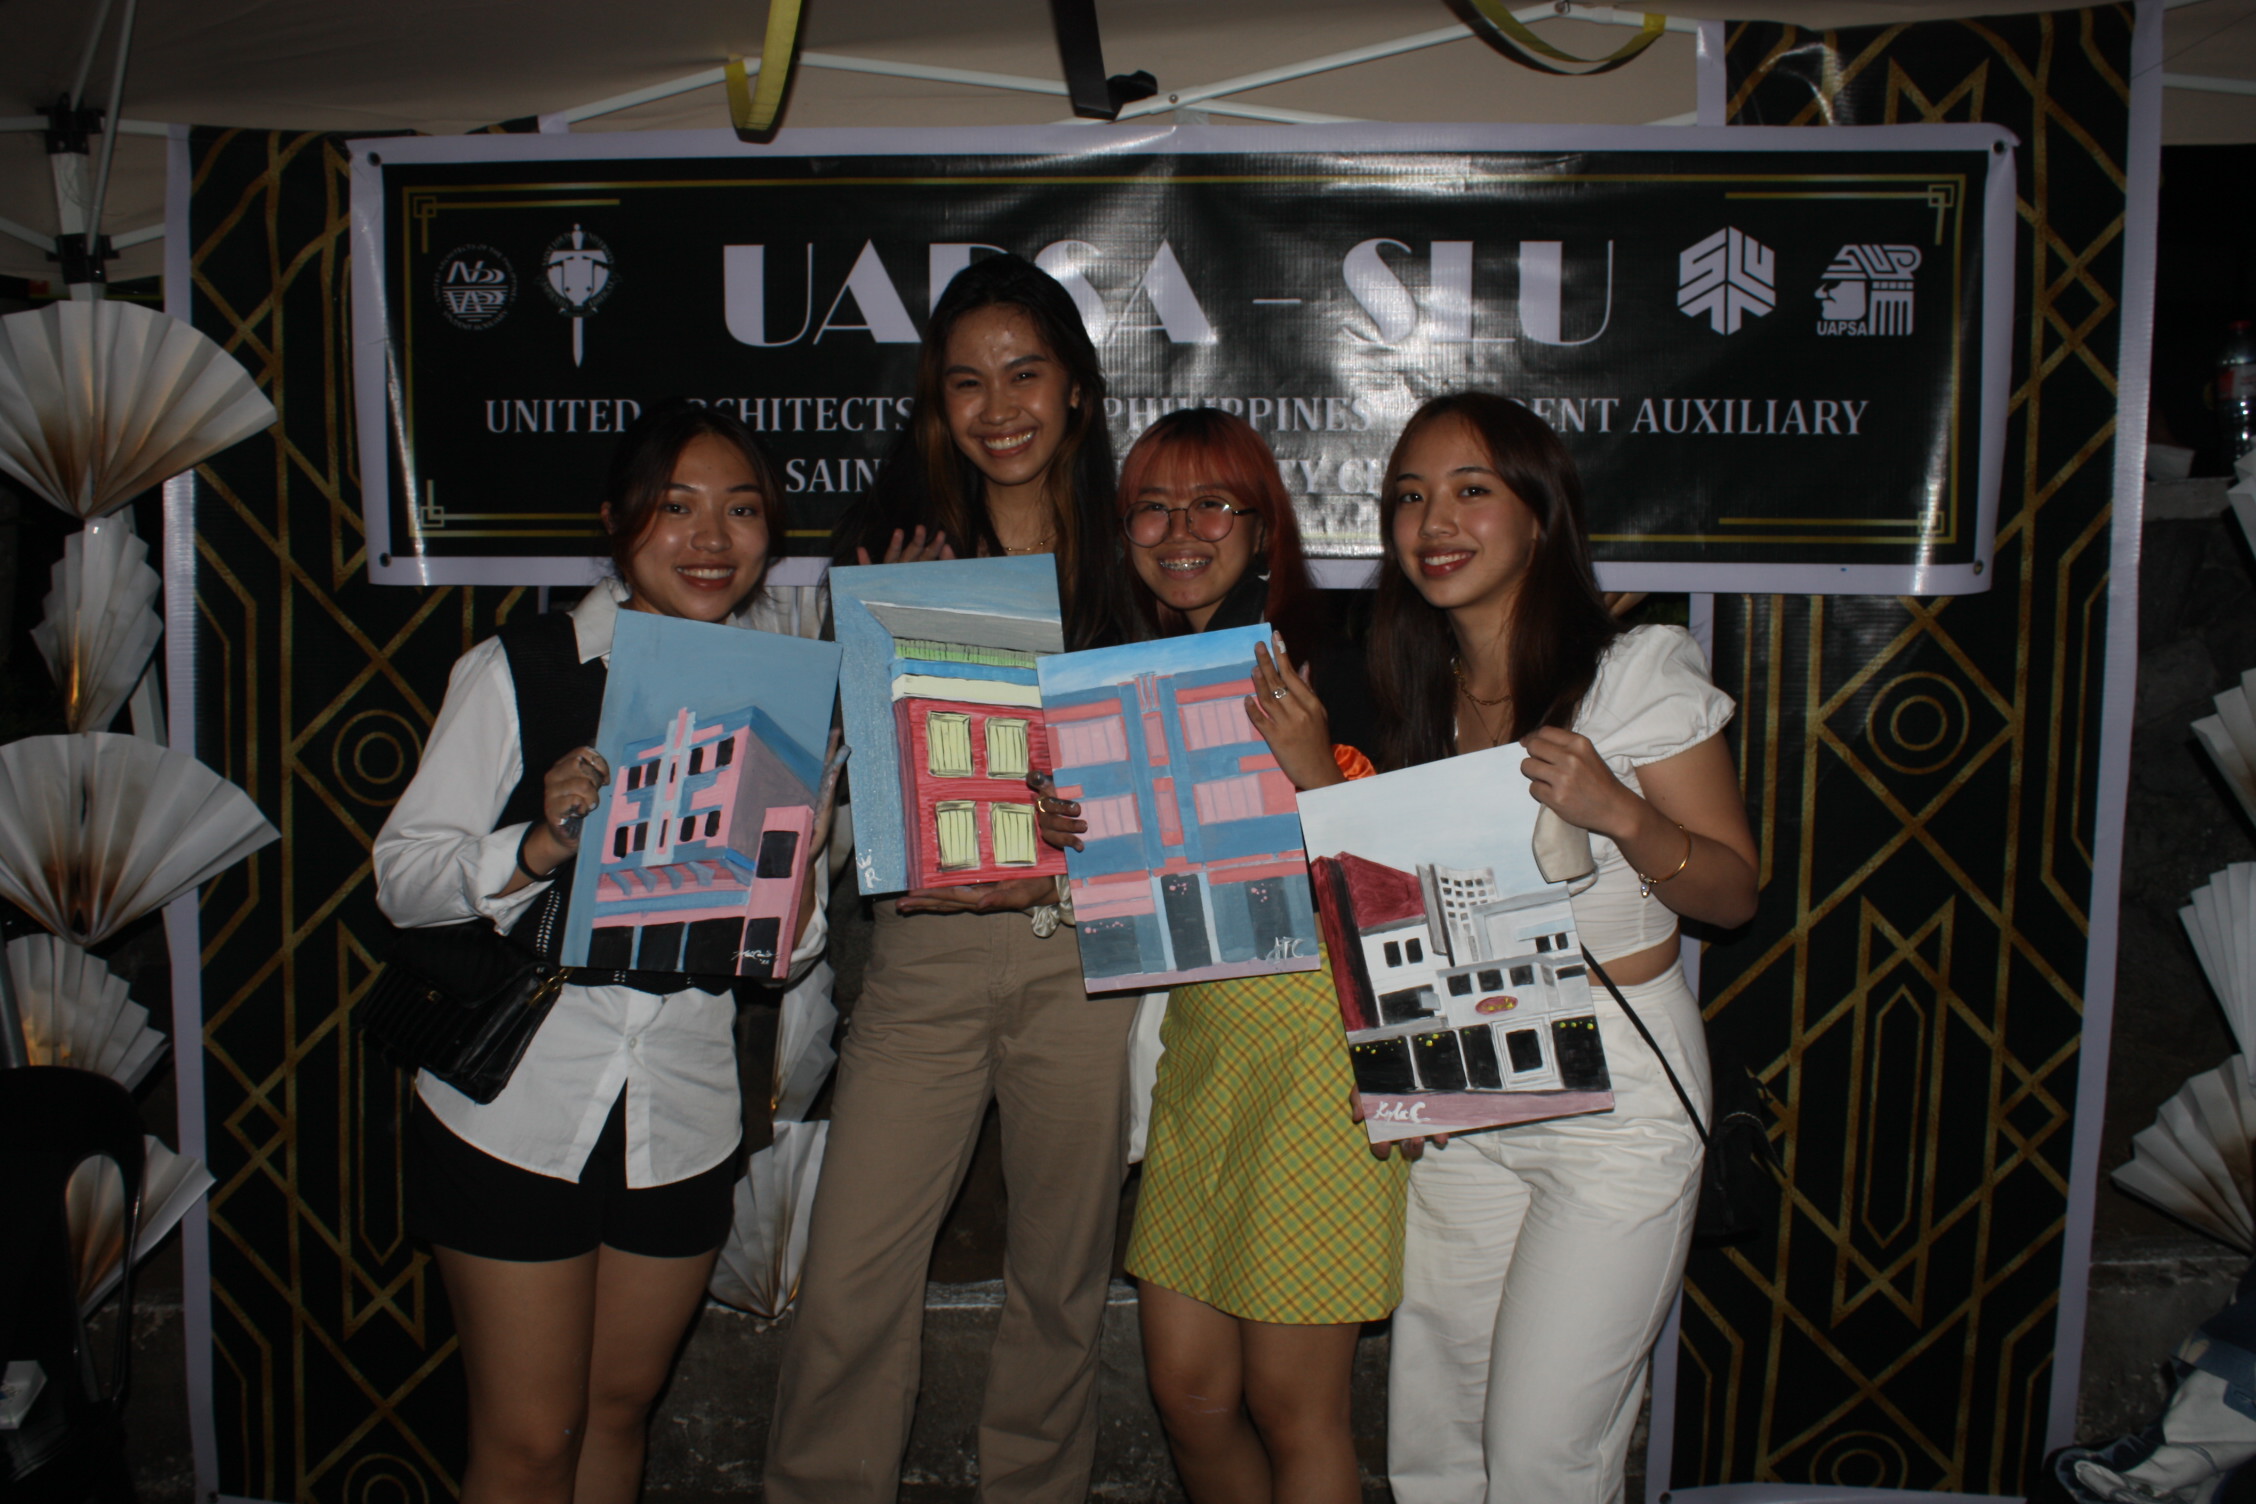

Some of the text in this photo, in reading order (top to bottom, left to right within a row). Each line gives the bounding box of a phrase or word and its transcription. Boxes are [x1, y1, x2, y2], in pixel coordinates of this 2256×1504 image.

[1341, 238, 1614, 346] SLU
[1816, 320, 1868, 337] UAPSA
[485, 398, 642, 433] UNITED
[1630, 397, 1870, 436] AUXILIARY
[785, 457, 888, 494] SAIN
